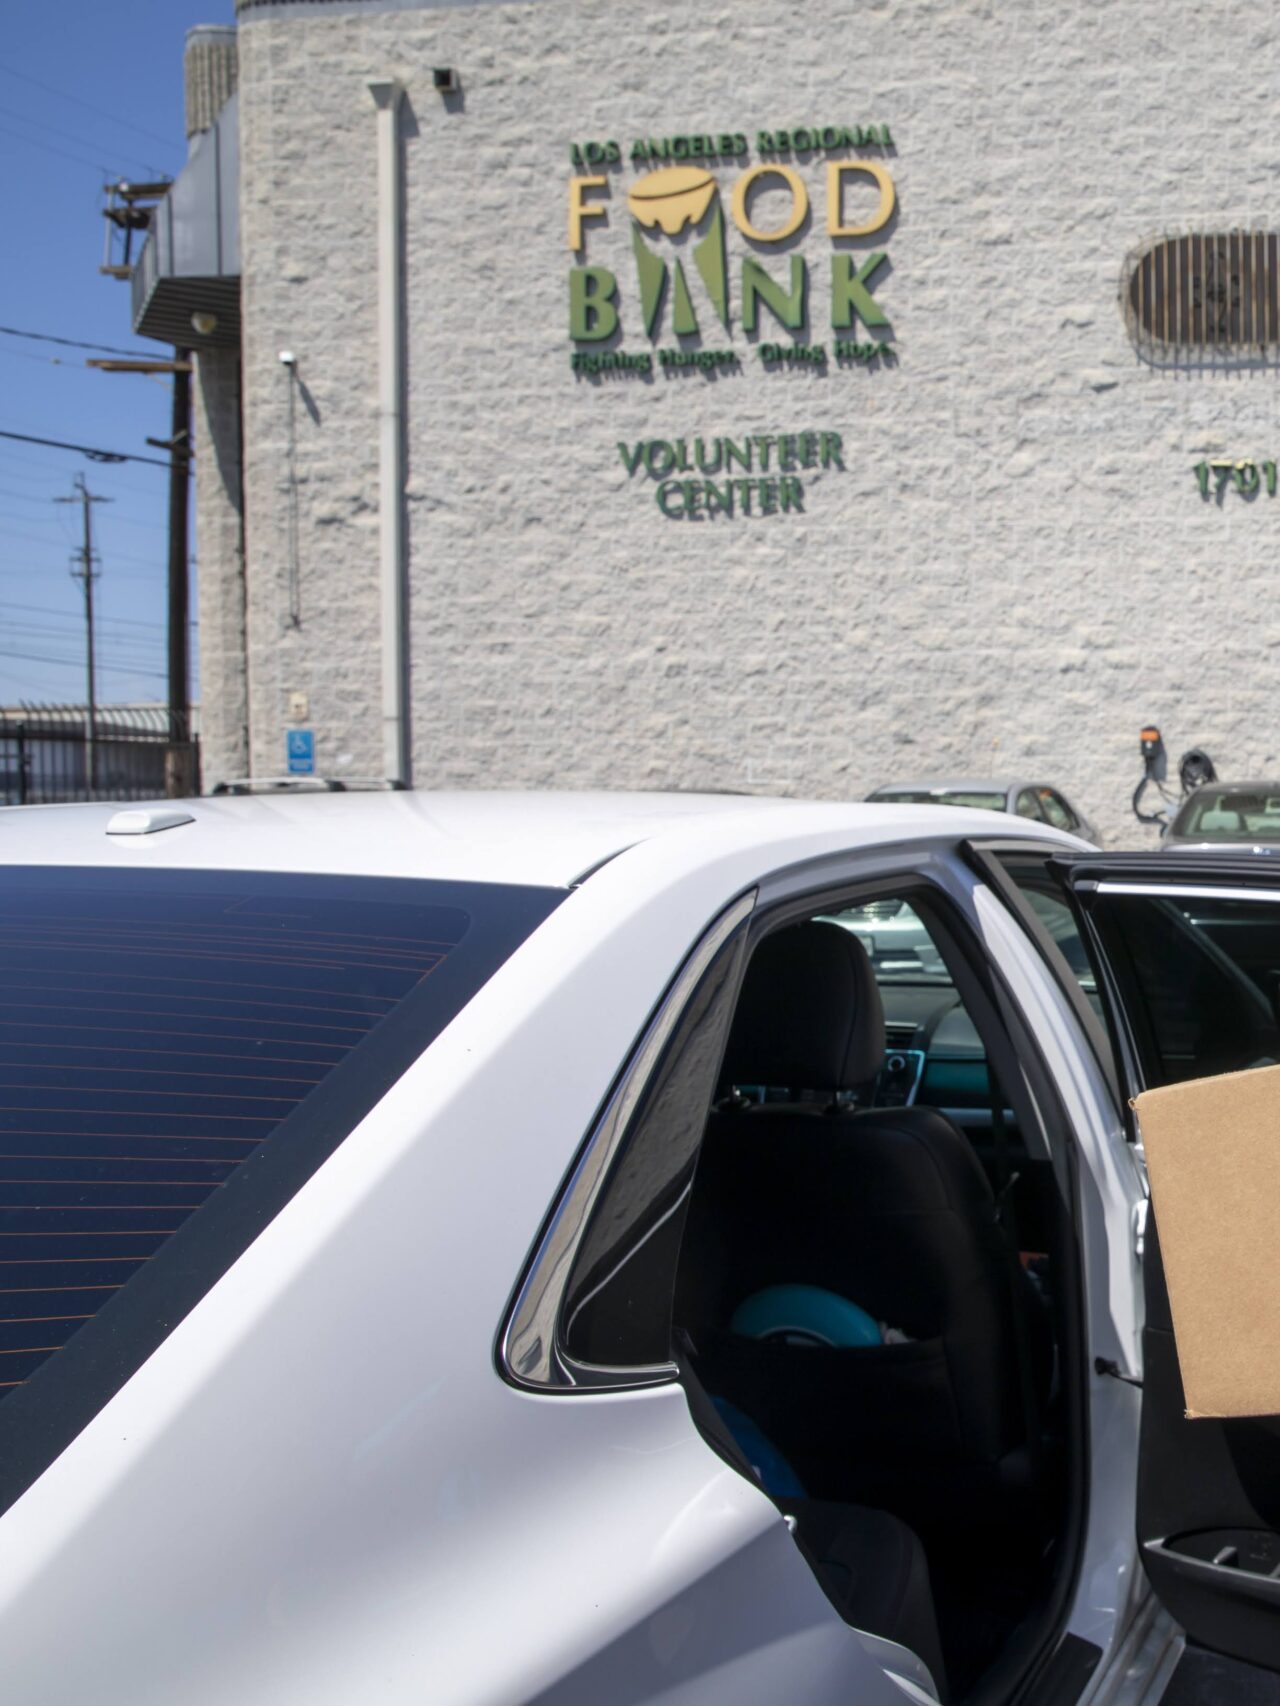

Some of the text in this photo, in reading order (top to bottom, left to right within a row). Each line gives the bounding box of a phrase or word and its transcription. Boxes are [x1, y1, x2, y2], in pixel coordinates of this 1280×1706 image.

[570, 123, 895, 166] LOS ANGELES REGIONAL
[757, 341, 825, 364] Giving
[617, 432, 846, 477] VOLUNTEER
[656, 476, 805, 520] CENTER
[1193, 457, 1277, 497] 1701
